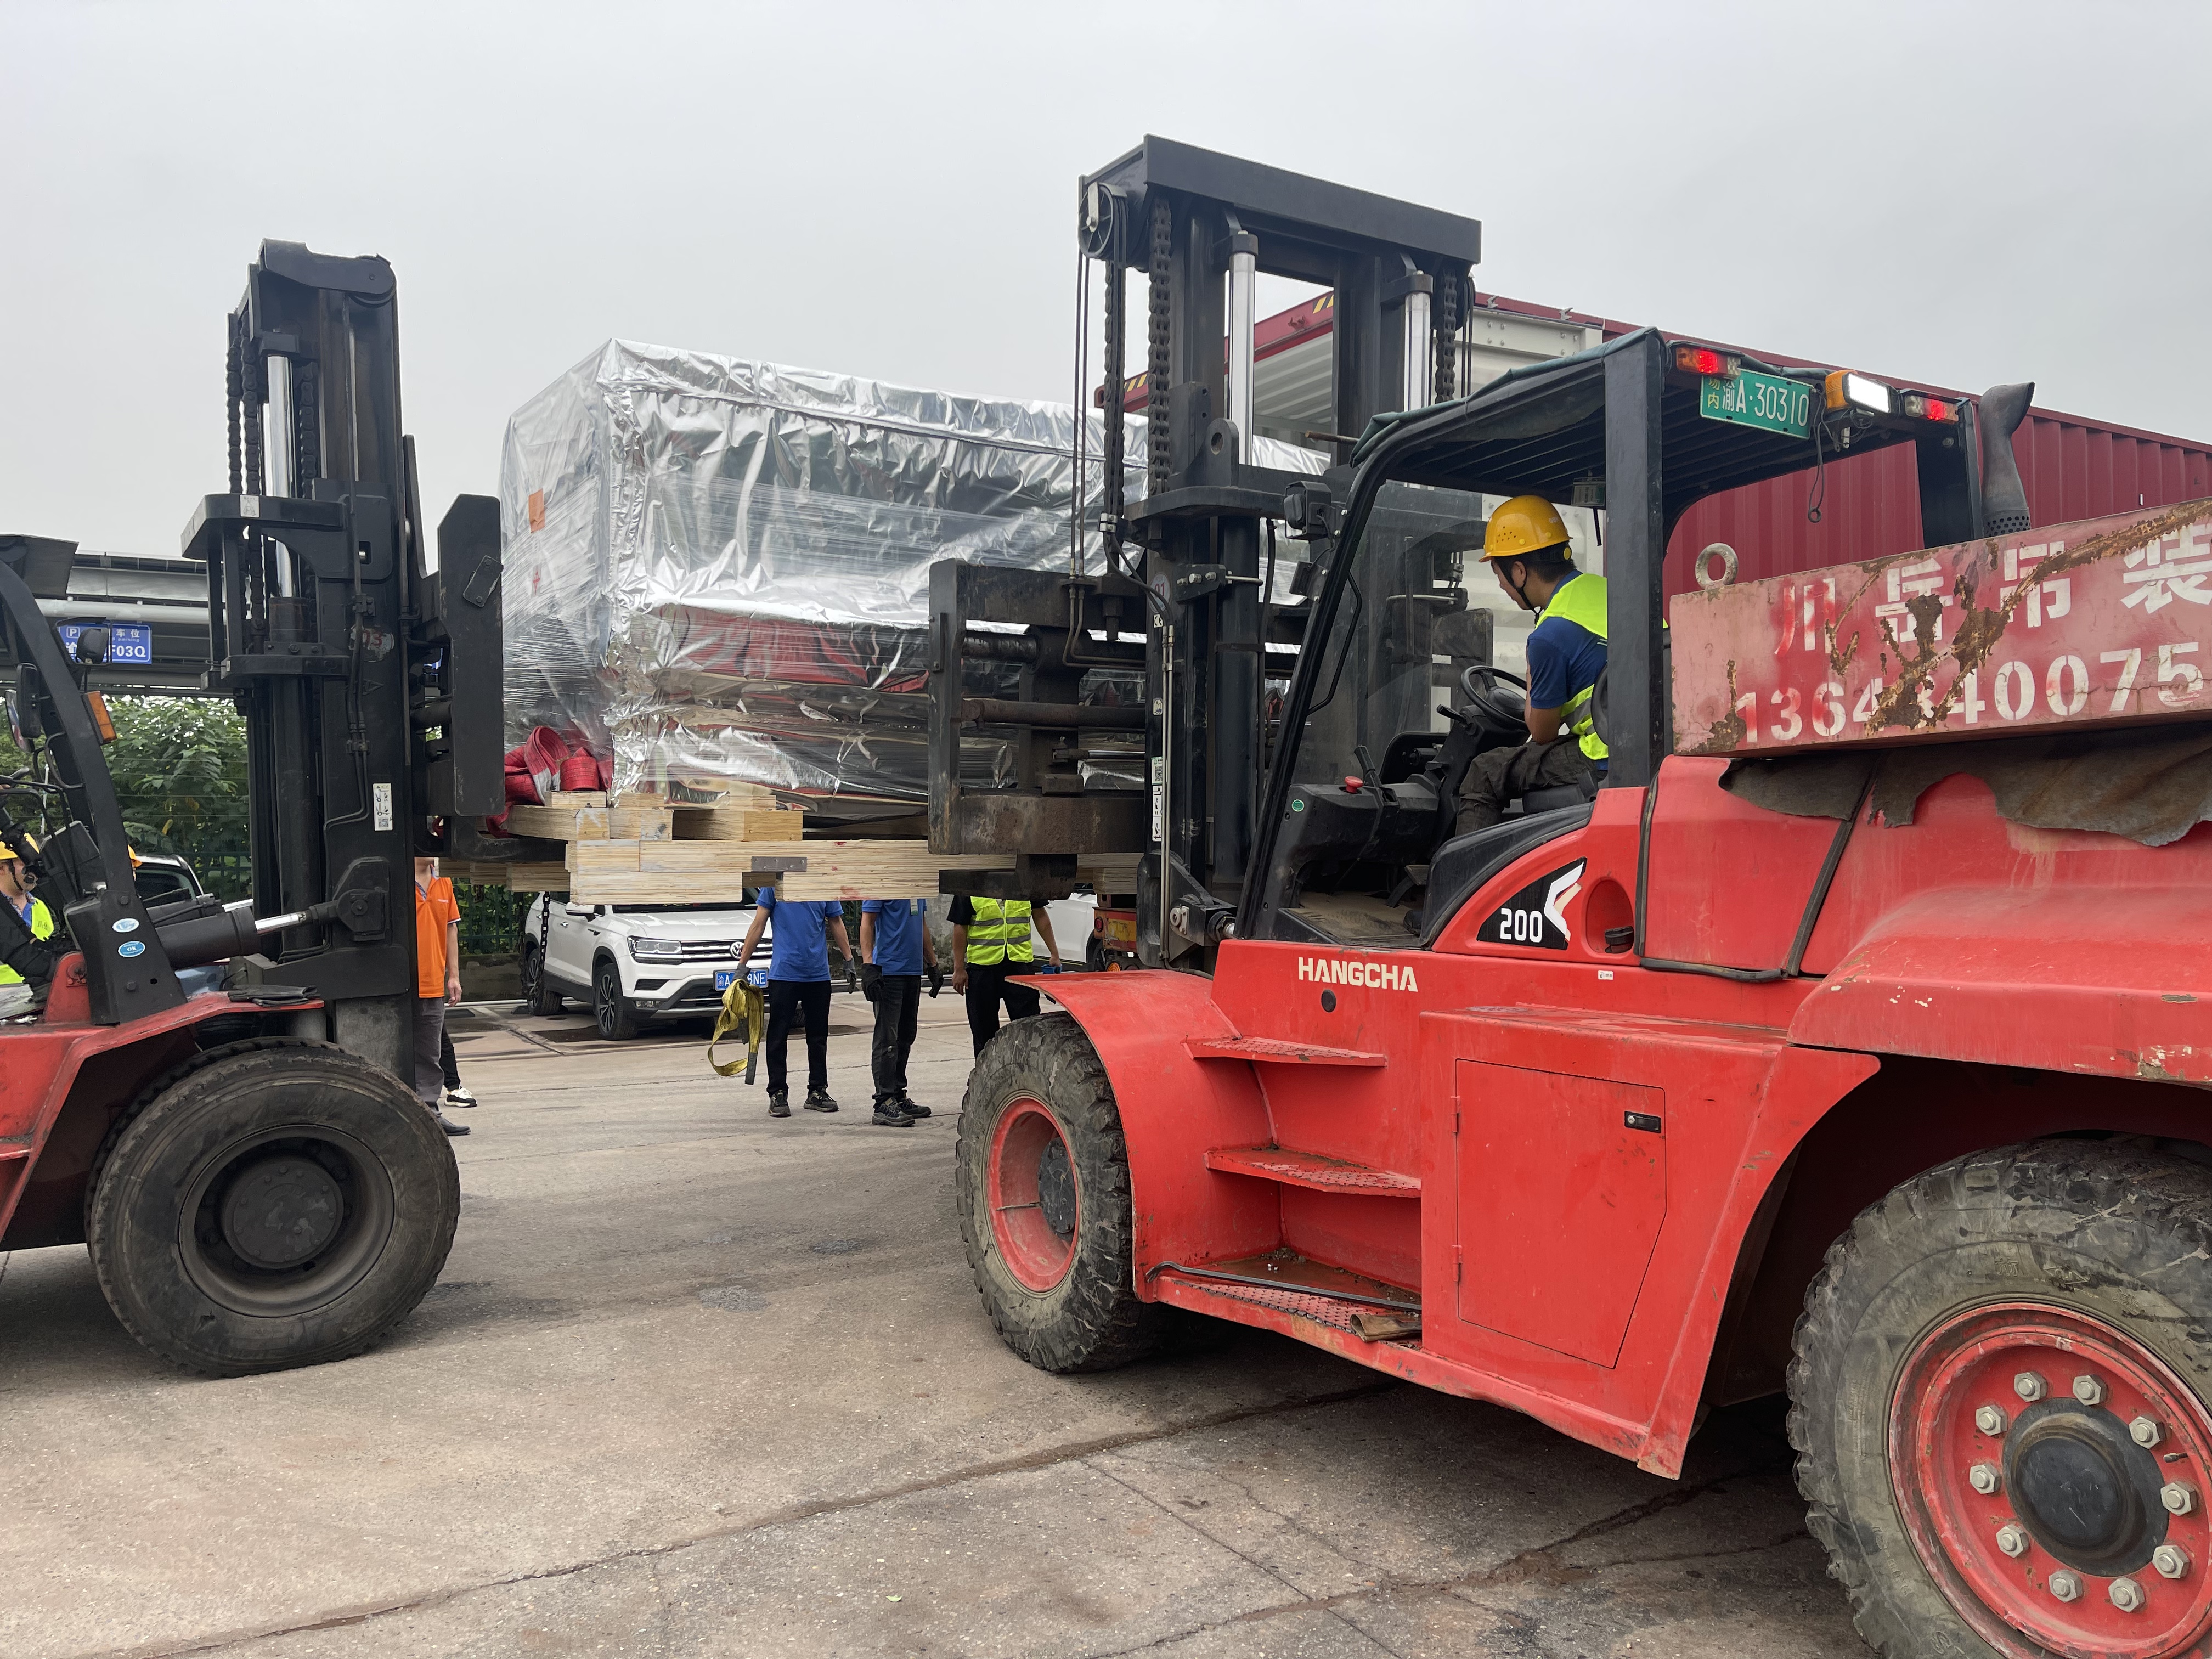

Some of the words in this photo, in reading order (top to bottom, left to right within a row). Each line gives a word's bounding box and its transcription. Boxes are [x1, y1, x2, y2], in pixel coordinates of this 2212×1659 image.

[1736, 641, 2204, 743] 136440075
[1500, 908, 1543, 943] 200
[718, 972, 766, 987] 渝A8NE
[1298, 957, 1418, 992] HANGCHA
